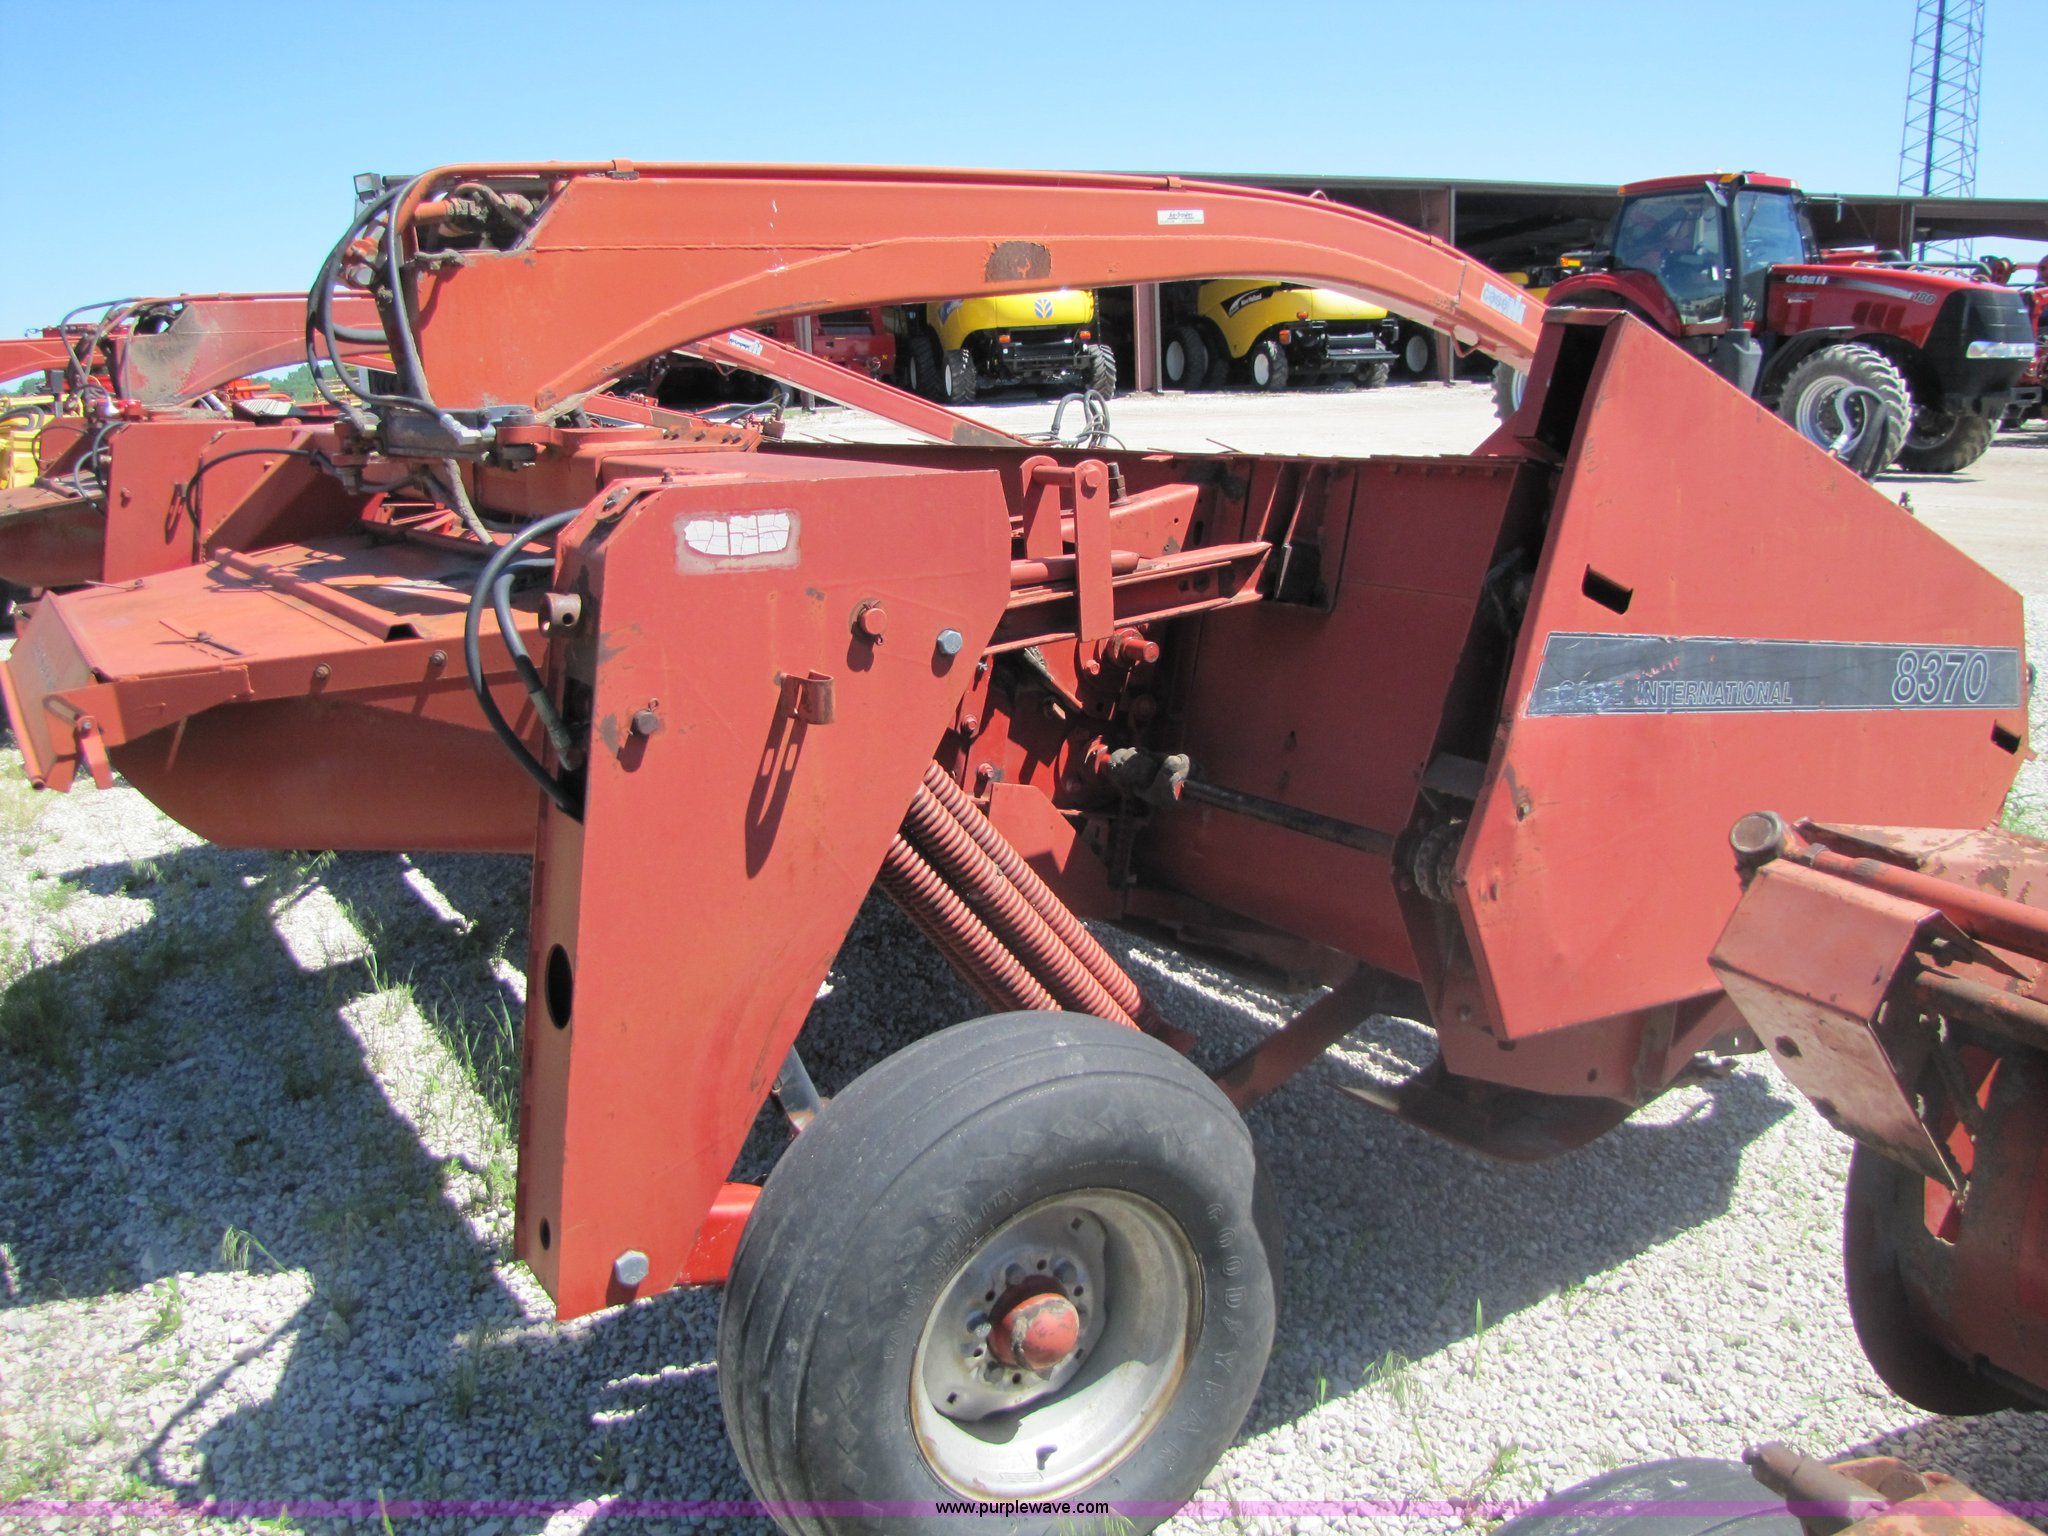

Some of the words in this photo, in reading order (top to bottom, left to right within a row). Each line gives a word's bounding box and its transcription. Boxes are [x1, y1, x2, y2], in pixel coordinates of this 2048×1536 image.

[1785, 274, 1816, 285] CASE
[1912, 291, 1937, 305] 180
[1892, 650, 1989, 703] 8370
[1637, 680, 1793, 704] INTERNATIONAL
[1163, 1203, 1246, 1472] GOODYEAR
